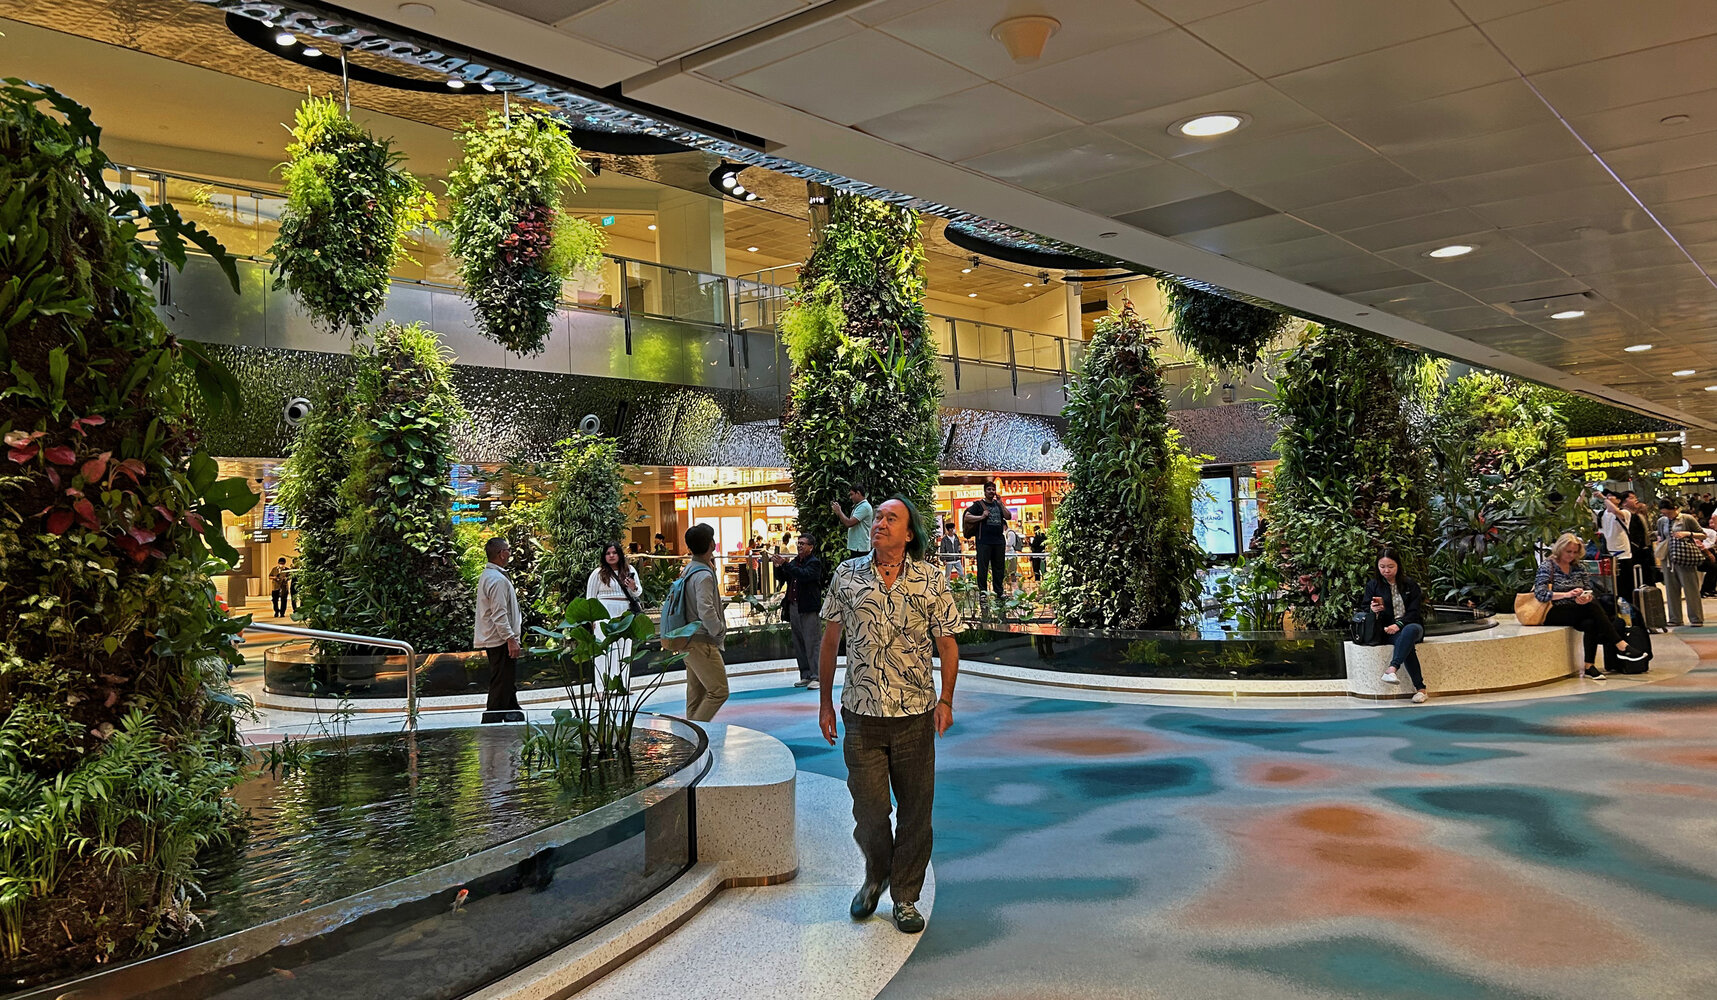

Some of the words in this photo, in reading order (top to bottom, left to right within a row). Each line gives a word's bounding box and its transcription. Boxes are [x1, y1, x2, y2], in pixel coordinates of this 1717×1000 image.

[603, 217, 612, 226] EXIT
[1588, 449, 1629, 461] Skytrain
[1631, 448, 1643, 457] to
[1005, 480, 1040, 493] LOTTE
[689, 493, 726, 508] WINES
[727, 492, 736, 506] &
[737, 489, 778, 505] SPIRITS
